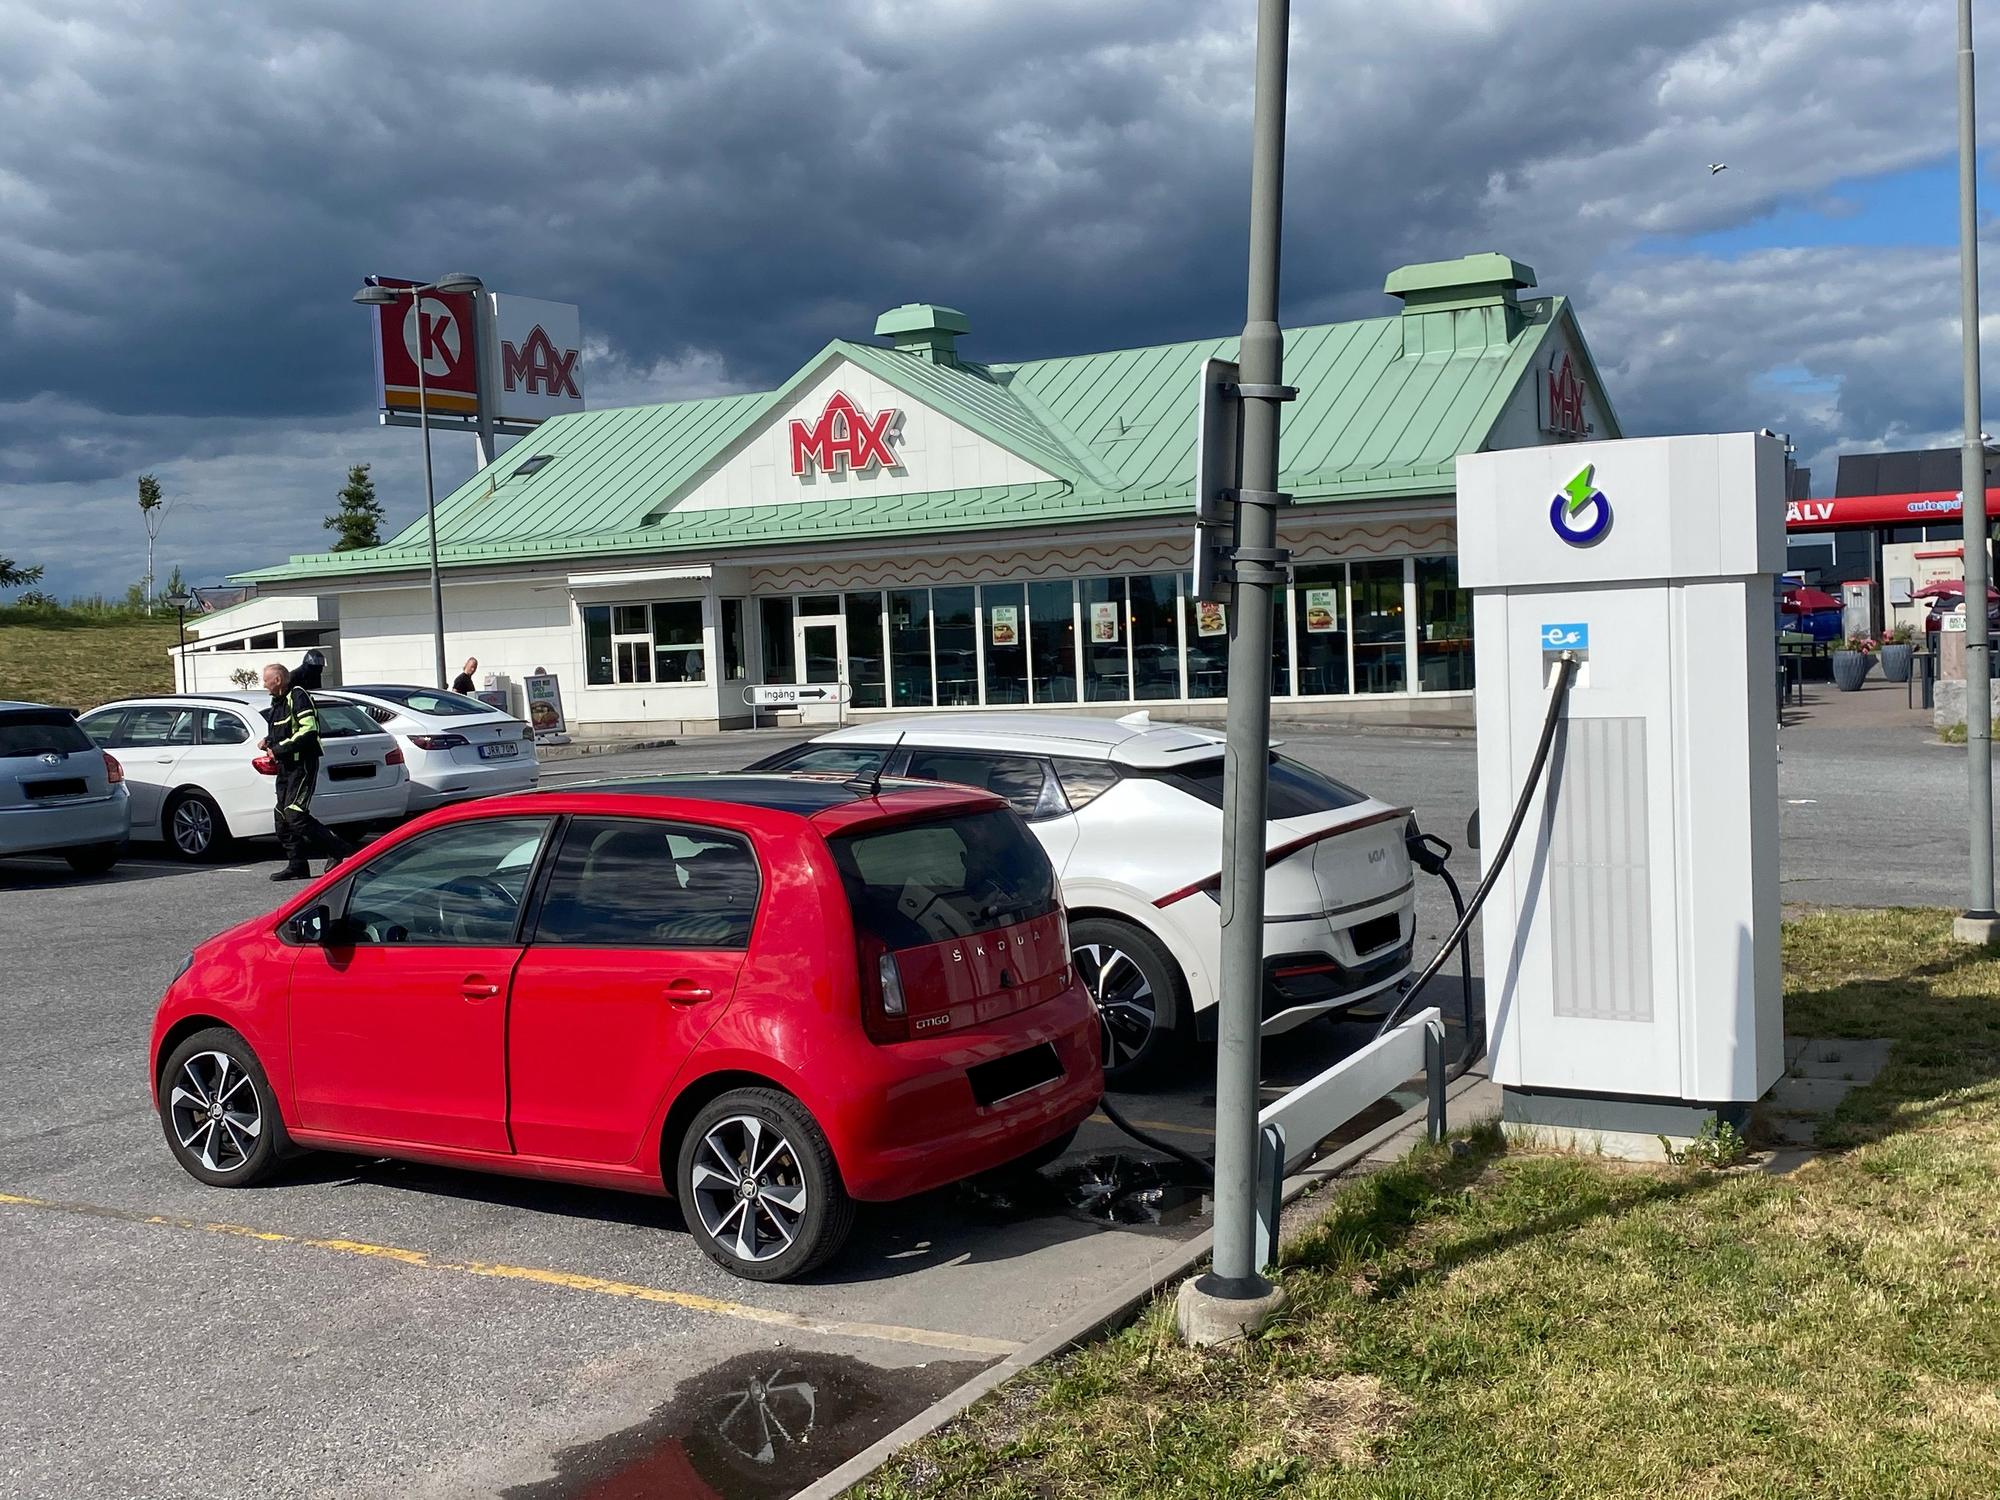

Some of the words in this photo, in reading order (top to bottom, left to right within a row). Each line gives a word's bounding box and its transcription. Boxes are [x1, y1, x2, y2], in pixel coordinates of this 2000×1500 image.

[501, 324, 581, 399] MAX
[1549, 352, 1587, 437] MAX
[789, 389, 899, 476] MAX
[952, 931, 1041, 962] ŠKODA
